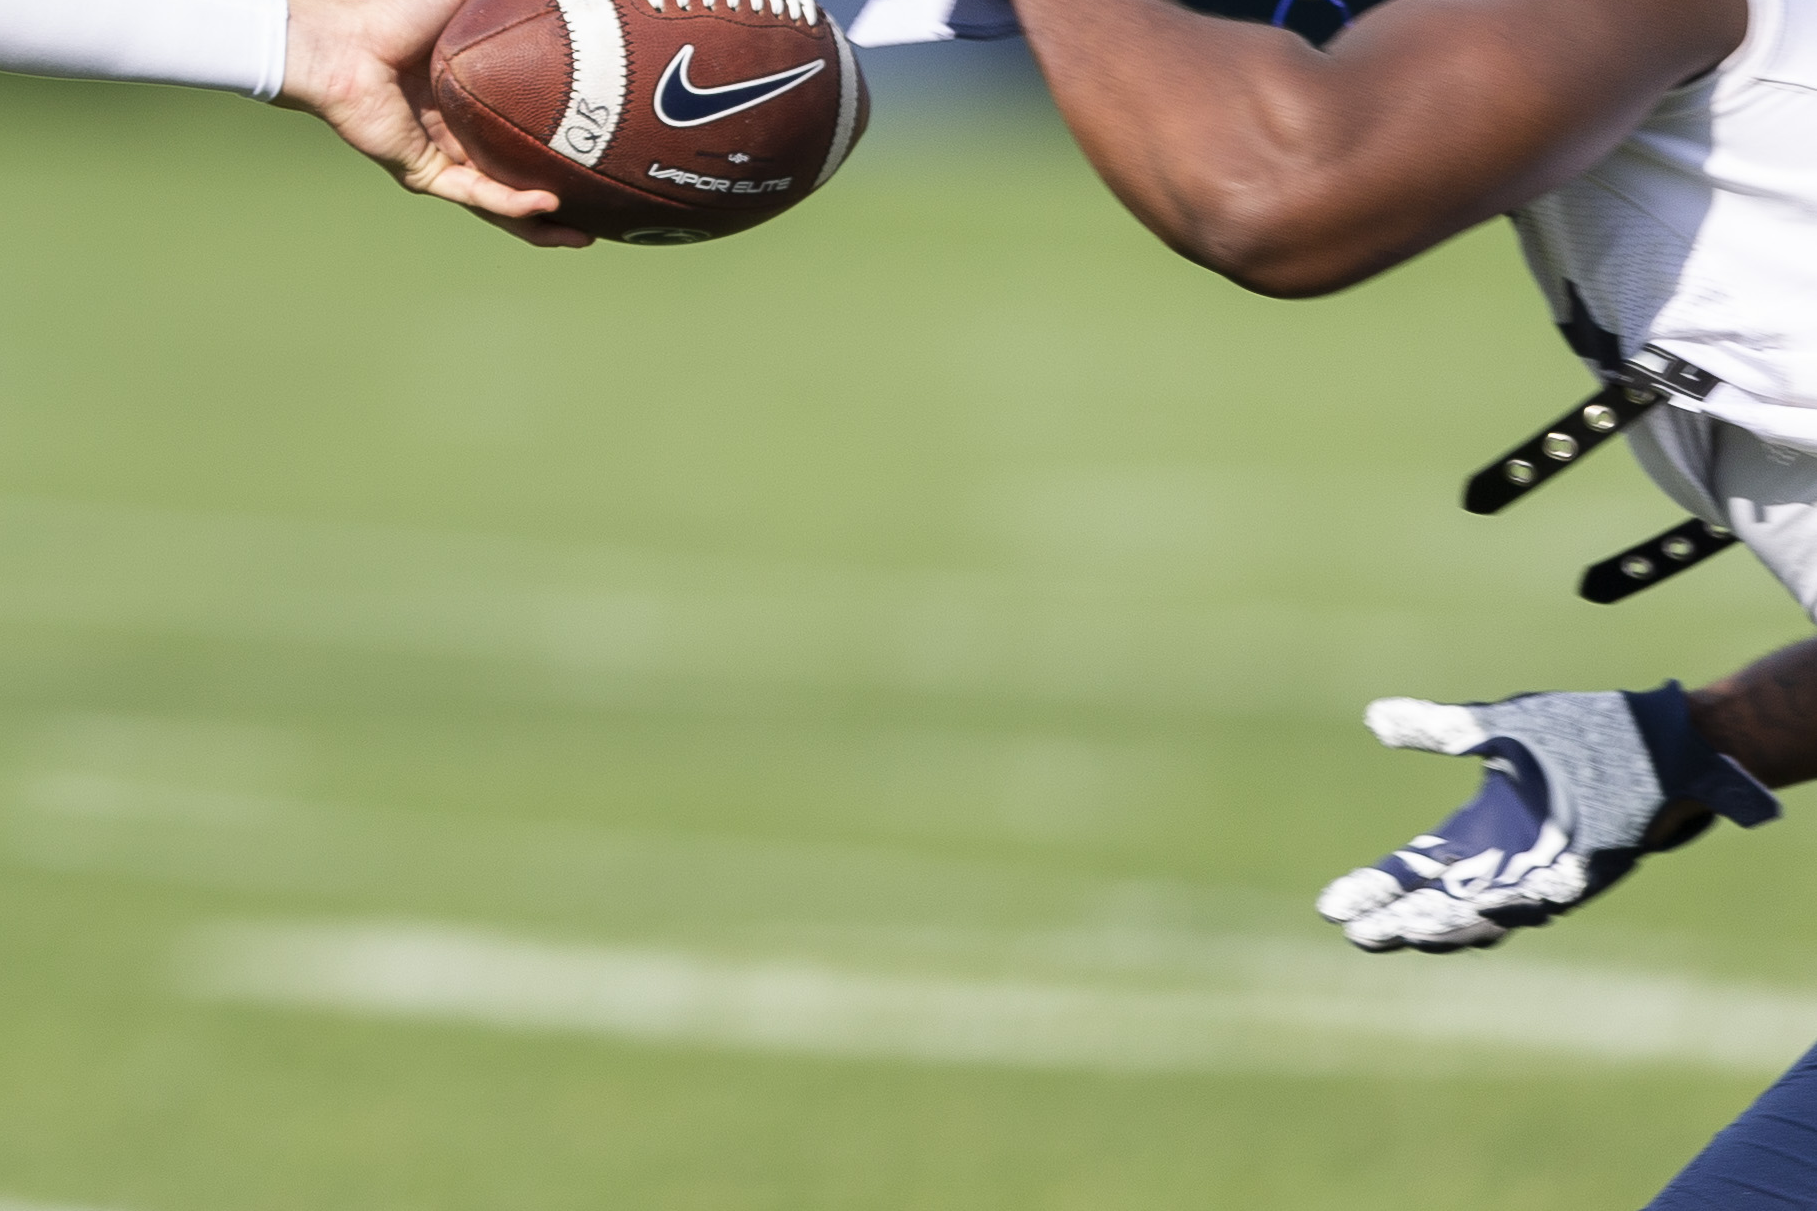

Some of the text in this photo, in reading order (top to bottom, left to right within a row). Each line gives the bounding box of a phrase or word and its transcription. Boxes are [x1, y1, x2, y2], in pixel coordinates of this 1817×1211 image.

[565, 97, 610, 154] QB
[647, 162, 793, 193] VAPOR ELITE
